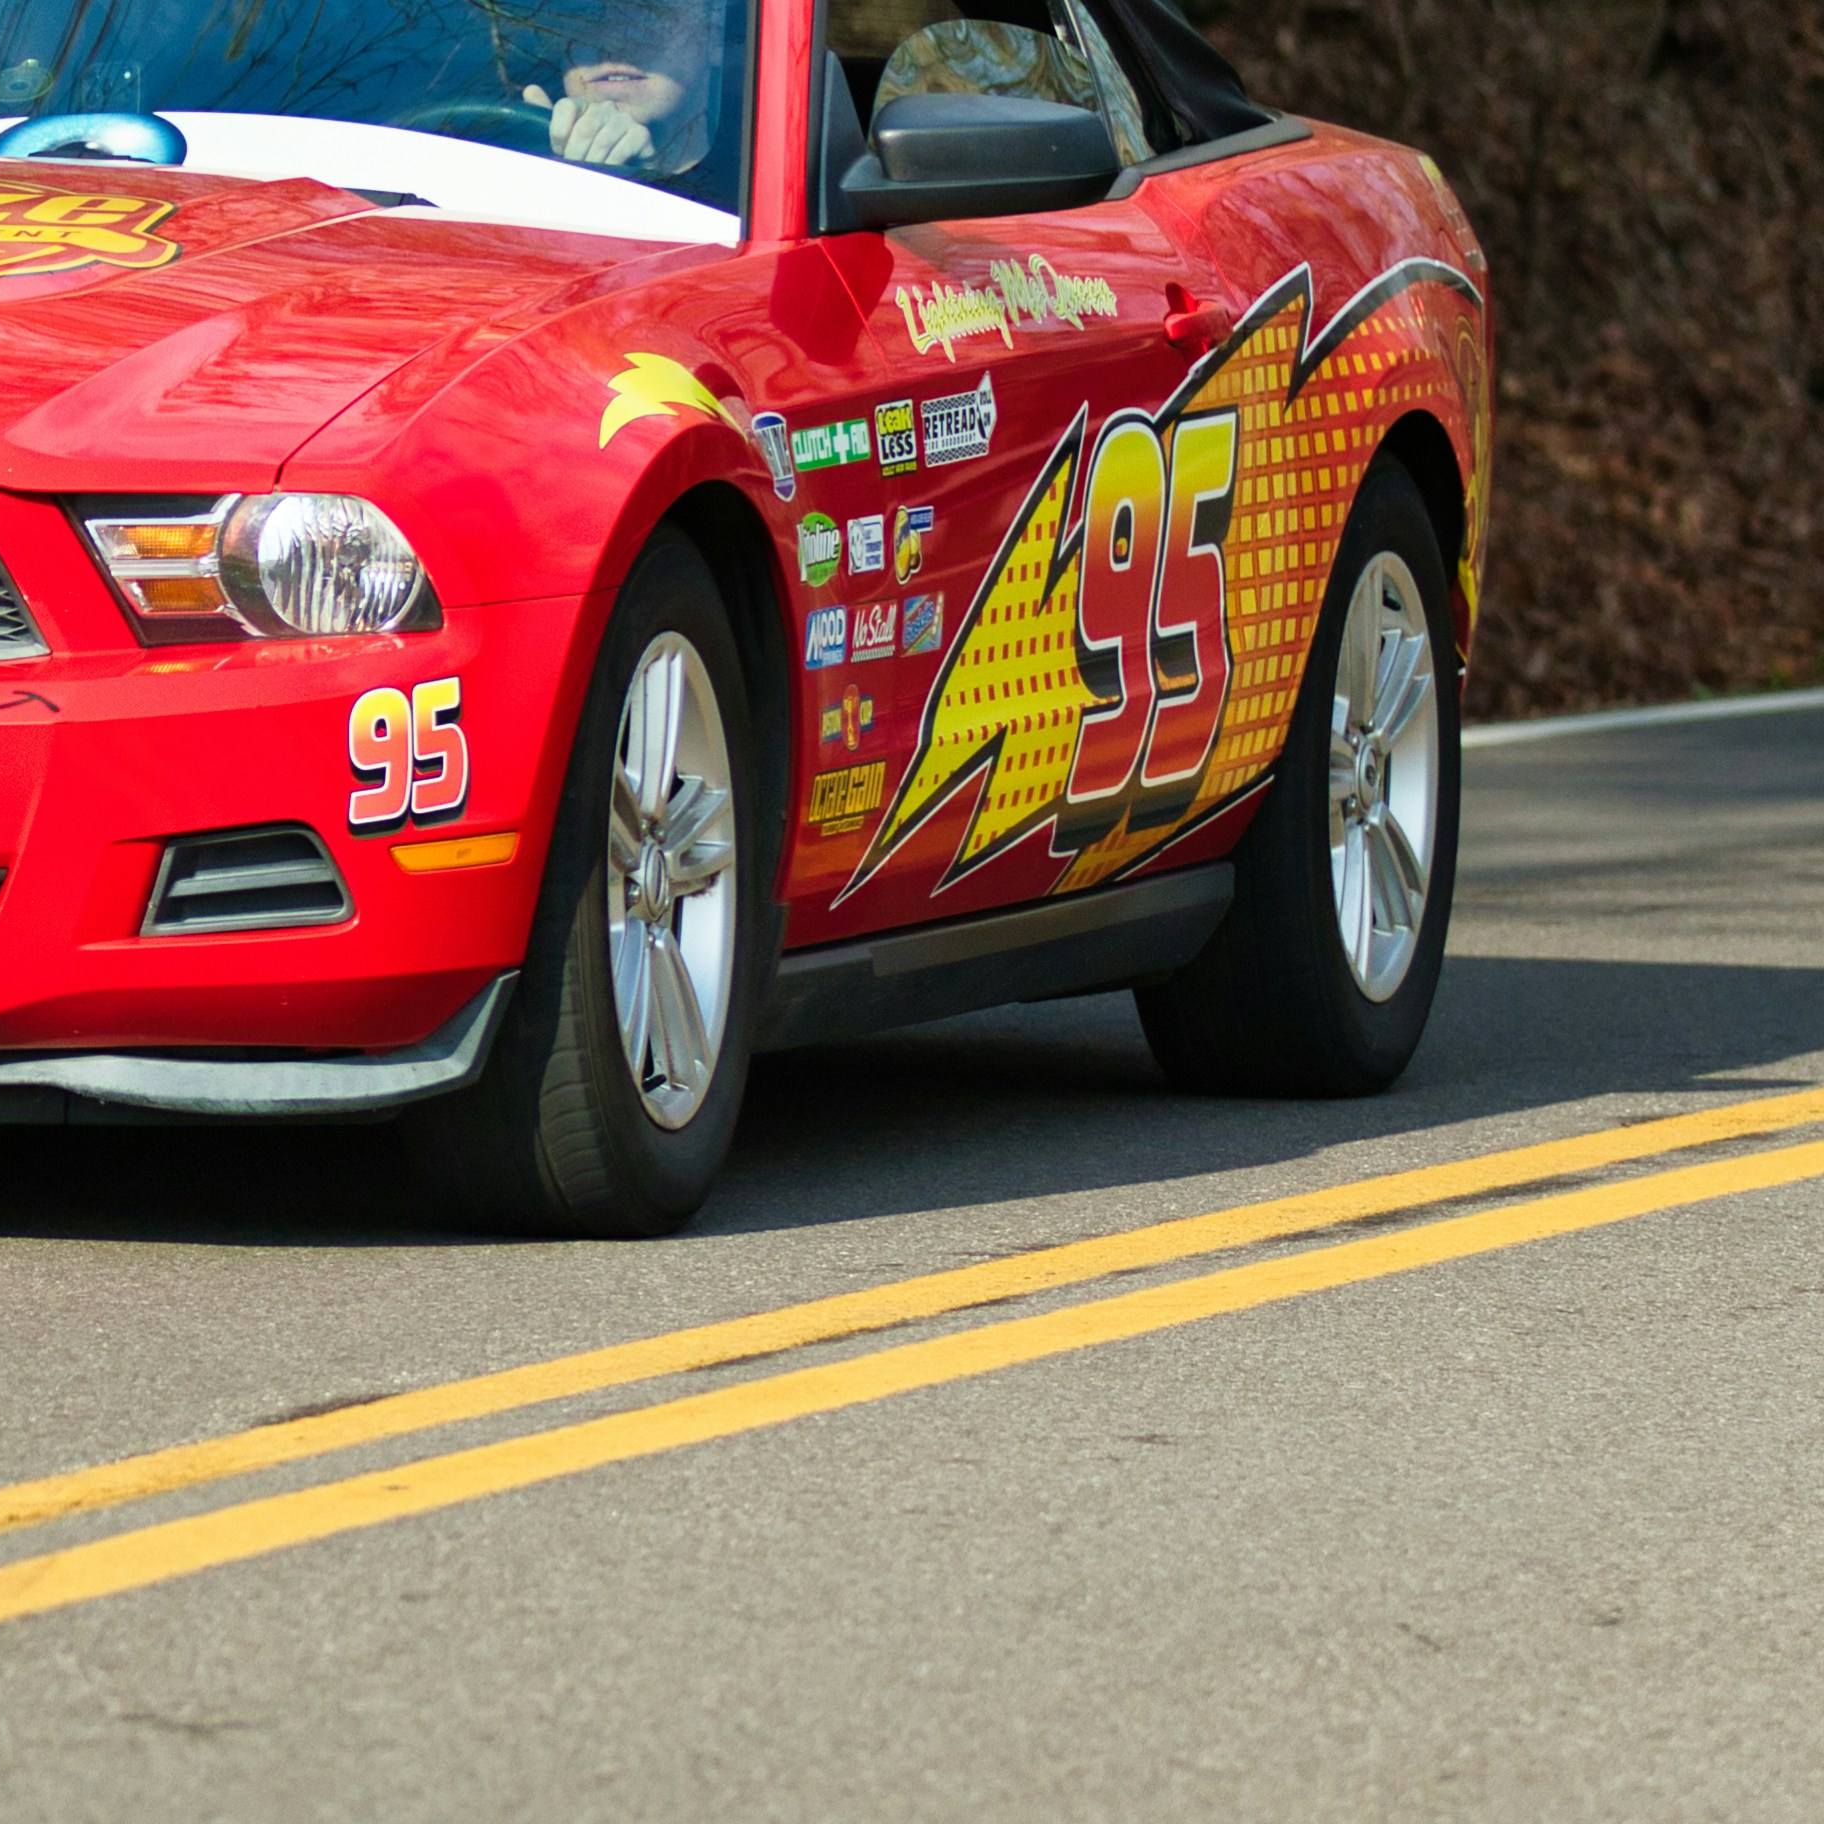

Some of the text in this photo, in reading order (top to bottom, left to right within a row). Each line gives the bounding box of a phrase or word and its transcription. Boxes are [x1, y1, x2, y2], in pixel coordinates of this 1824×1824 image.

[791, 426, 833, 464] CLUTCH
[924, 406, 976, 440] RETREAD
[1065, 410, 1238, 804] 95
[805, 608, 846, 662] MOOD
[348, 676, 469, 831] 95
